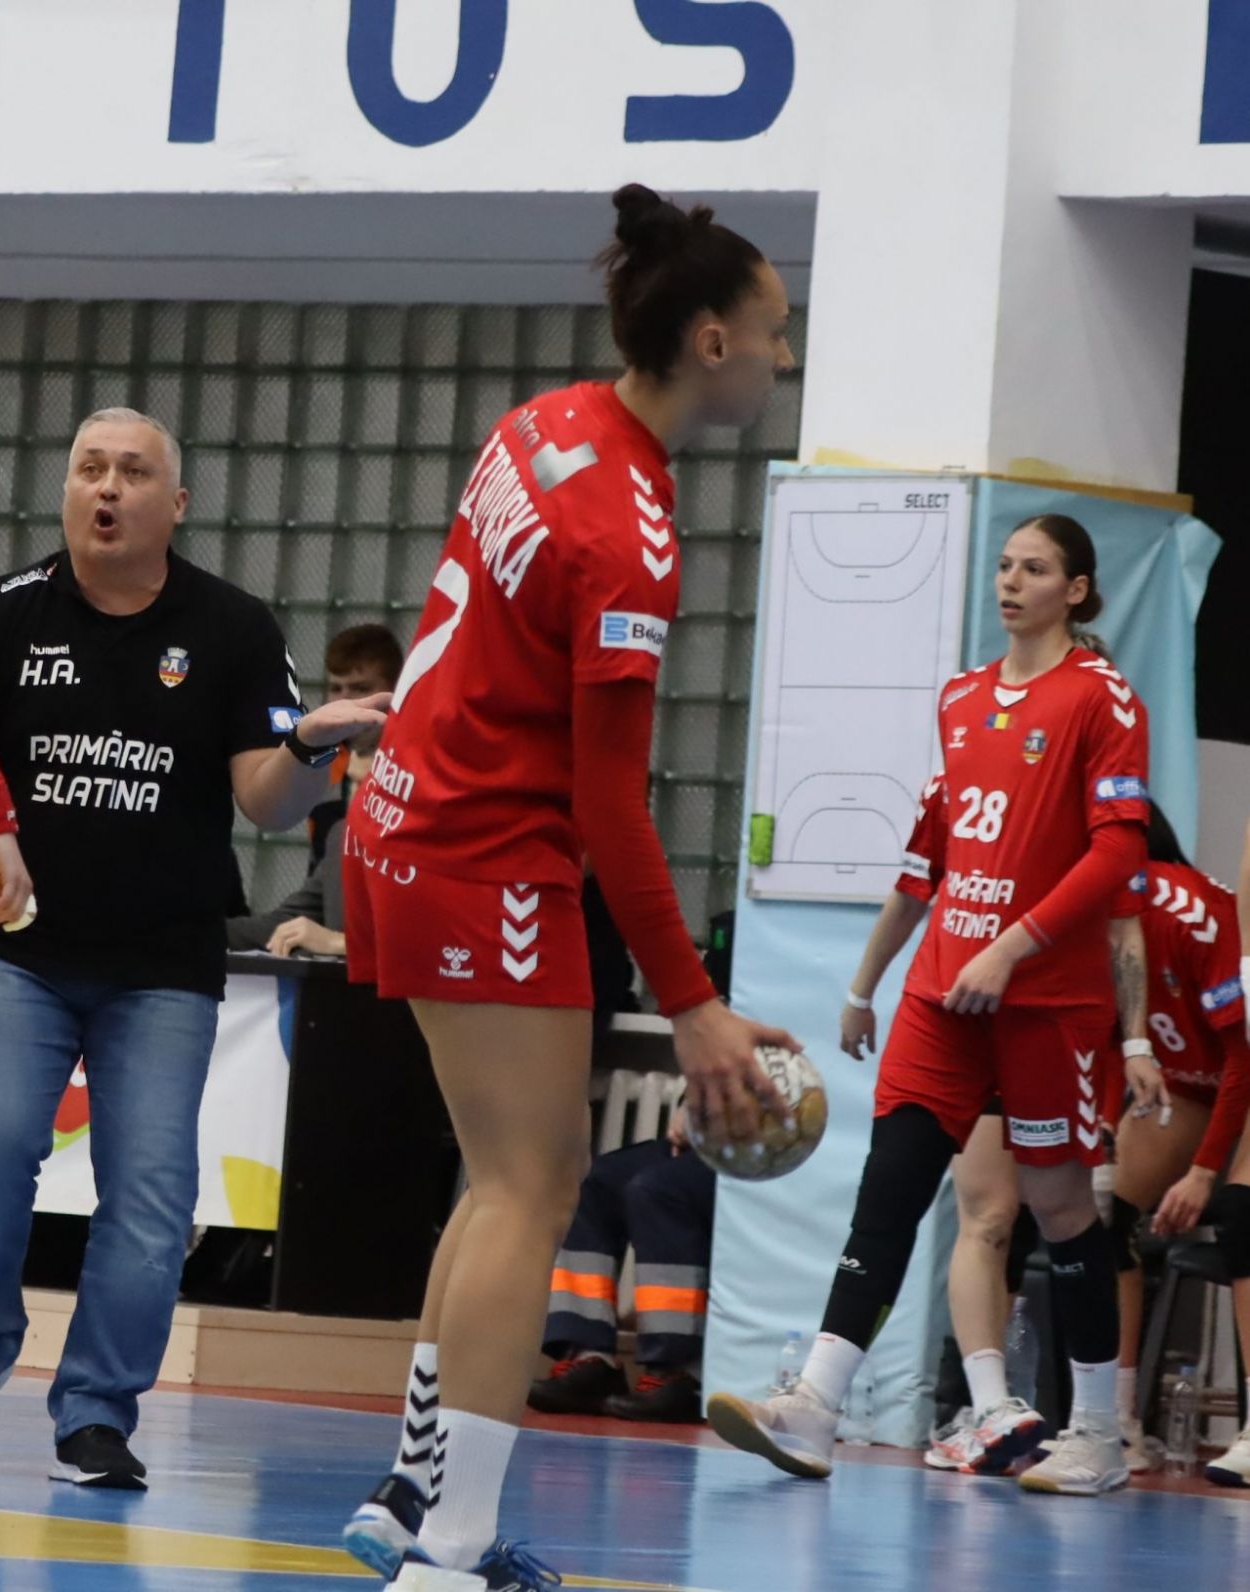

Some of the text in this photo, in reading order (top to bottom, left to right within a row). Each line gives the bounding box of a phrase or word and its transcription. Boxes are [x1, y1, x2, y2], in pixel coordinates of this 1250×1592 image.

[905, 493, 950, 508] SELECT
[19, 659, 81, 686] H.A.
[31, 772, 161, 813] SLATINA
[953, 786, 1008, 843] 28
